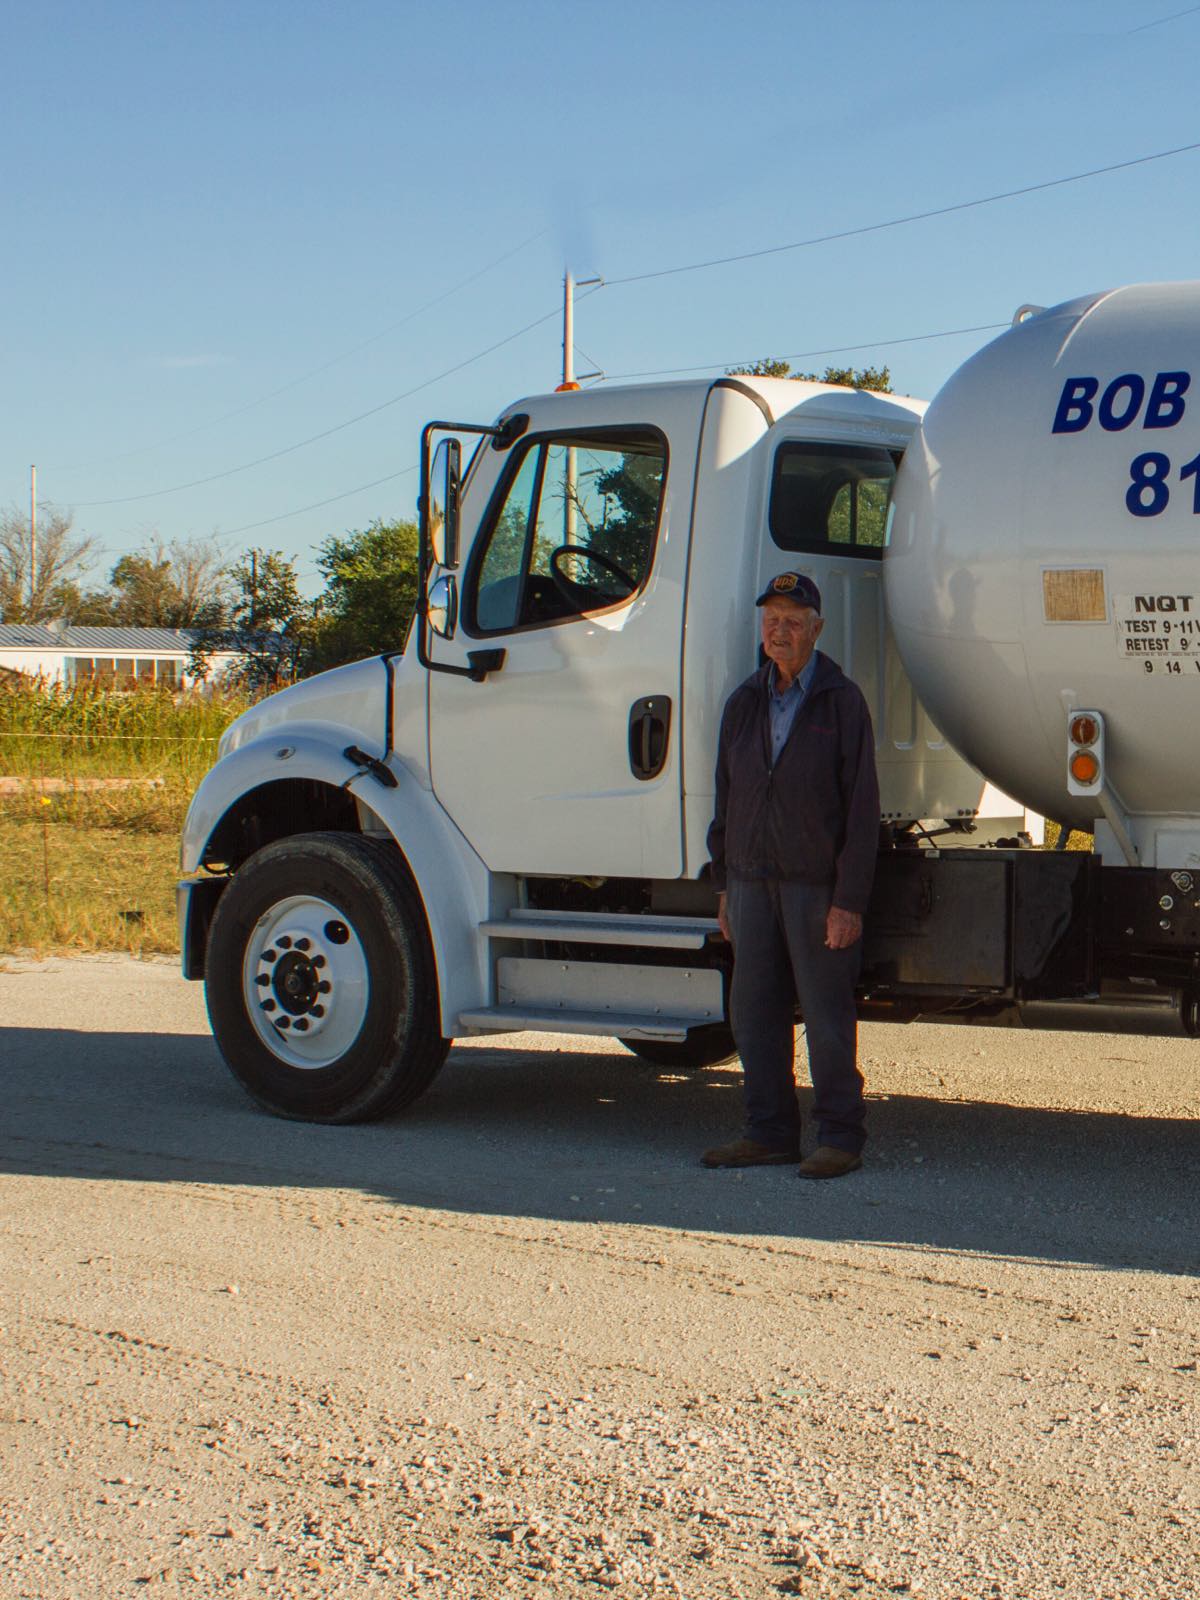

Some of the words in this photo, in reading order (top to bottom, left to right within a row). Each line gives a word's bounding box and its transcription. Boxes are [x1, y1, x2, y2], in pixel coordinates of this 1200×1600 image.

[1051, 369, 1190, 434] BOB
[1134, 595, 1194, 613] NQT
[1124, 619, 1157, 633] TEST
[1125, 637, 1170, 651] RETEST
[1144, 660, 1154, 674] 9
[1165, 660, 1182, 674] 14
